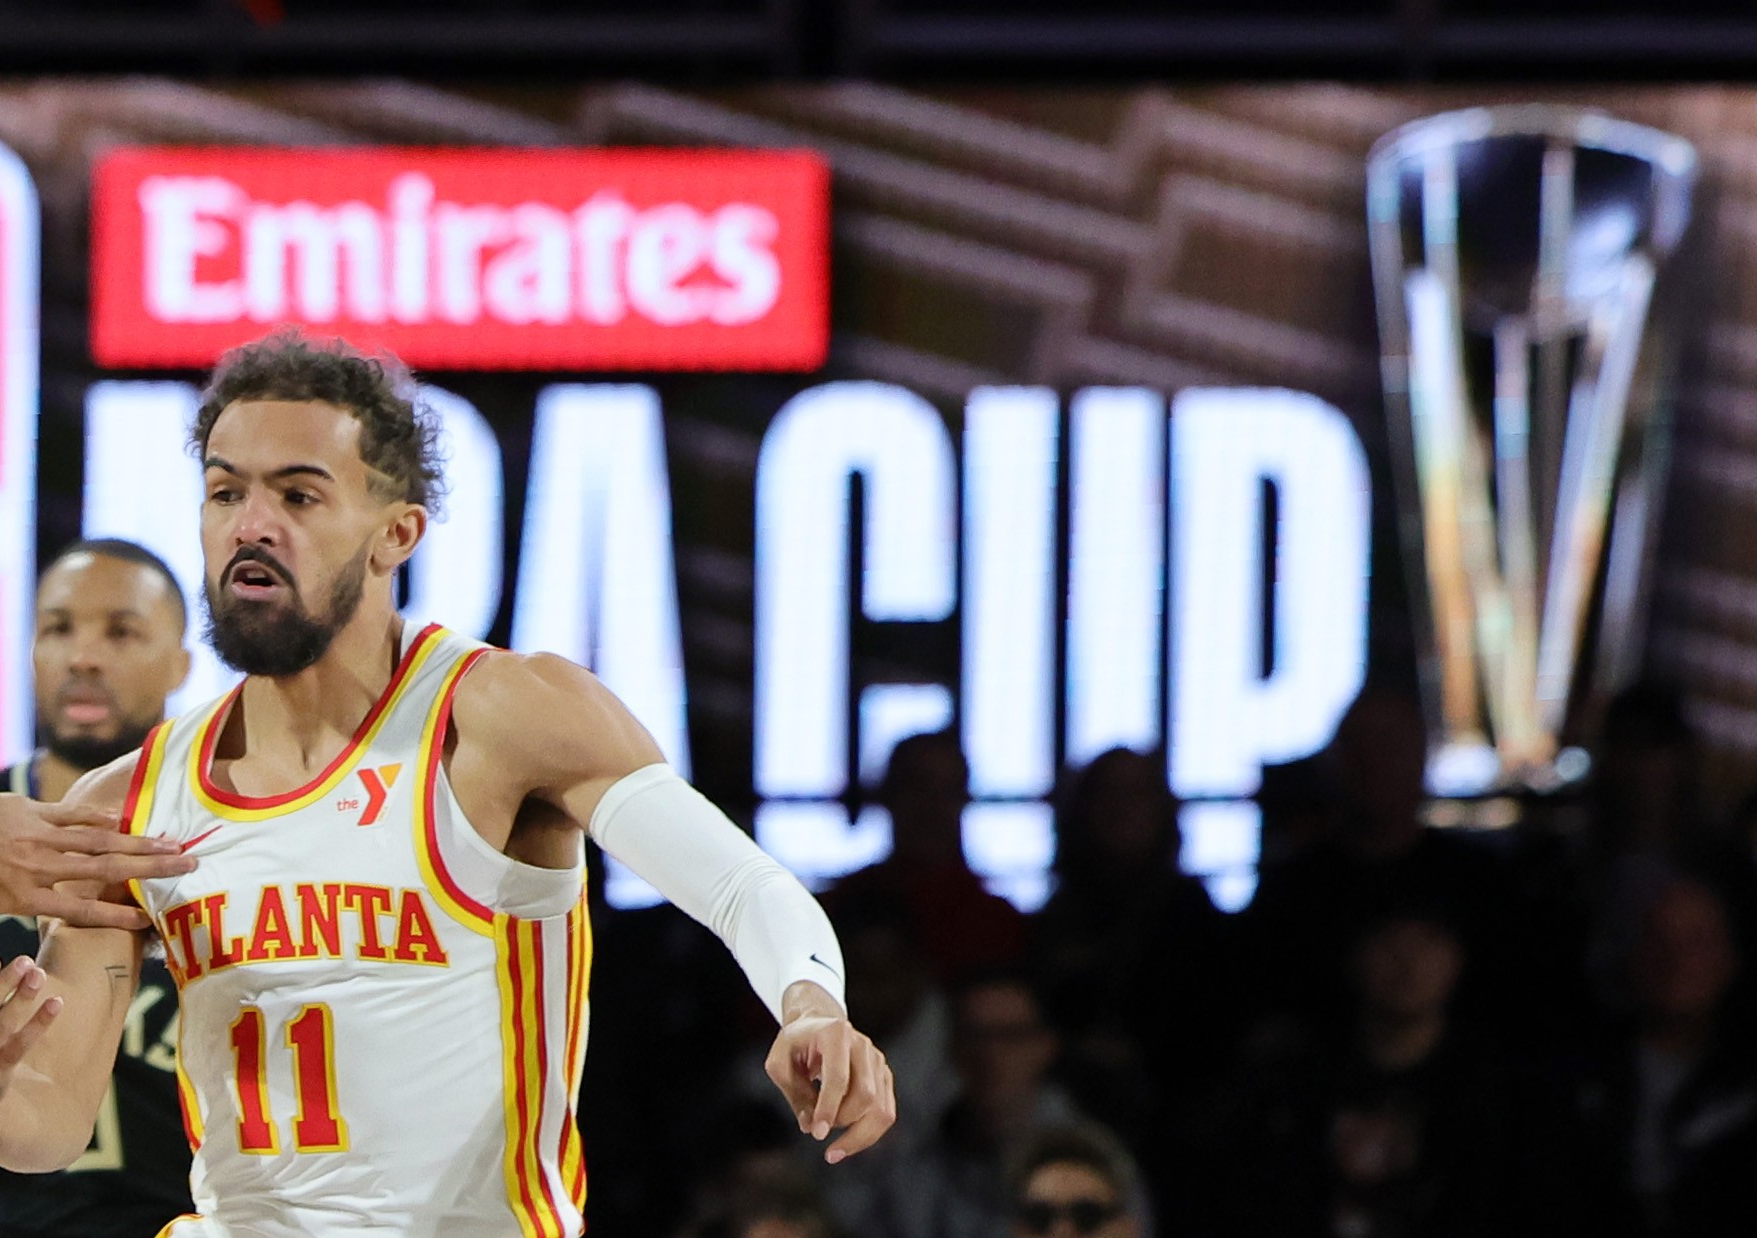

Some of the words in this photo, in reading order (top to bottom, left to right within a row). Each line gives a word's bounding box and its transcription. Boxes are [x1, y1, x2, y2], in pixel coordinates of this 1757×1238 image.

[139, 173, 780, 325] Emirates
[752, 378, 1374, 912] CUP
[336, 798, 359, 811] the
[229, 1002, 350, 1155] 11
